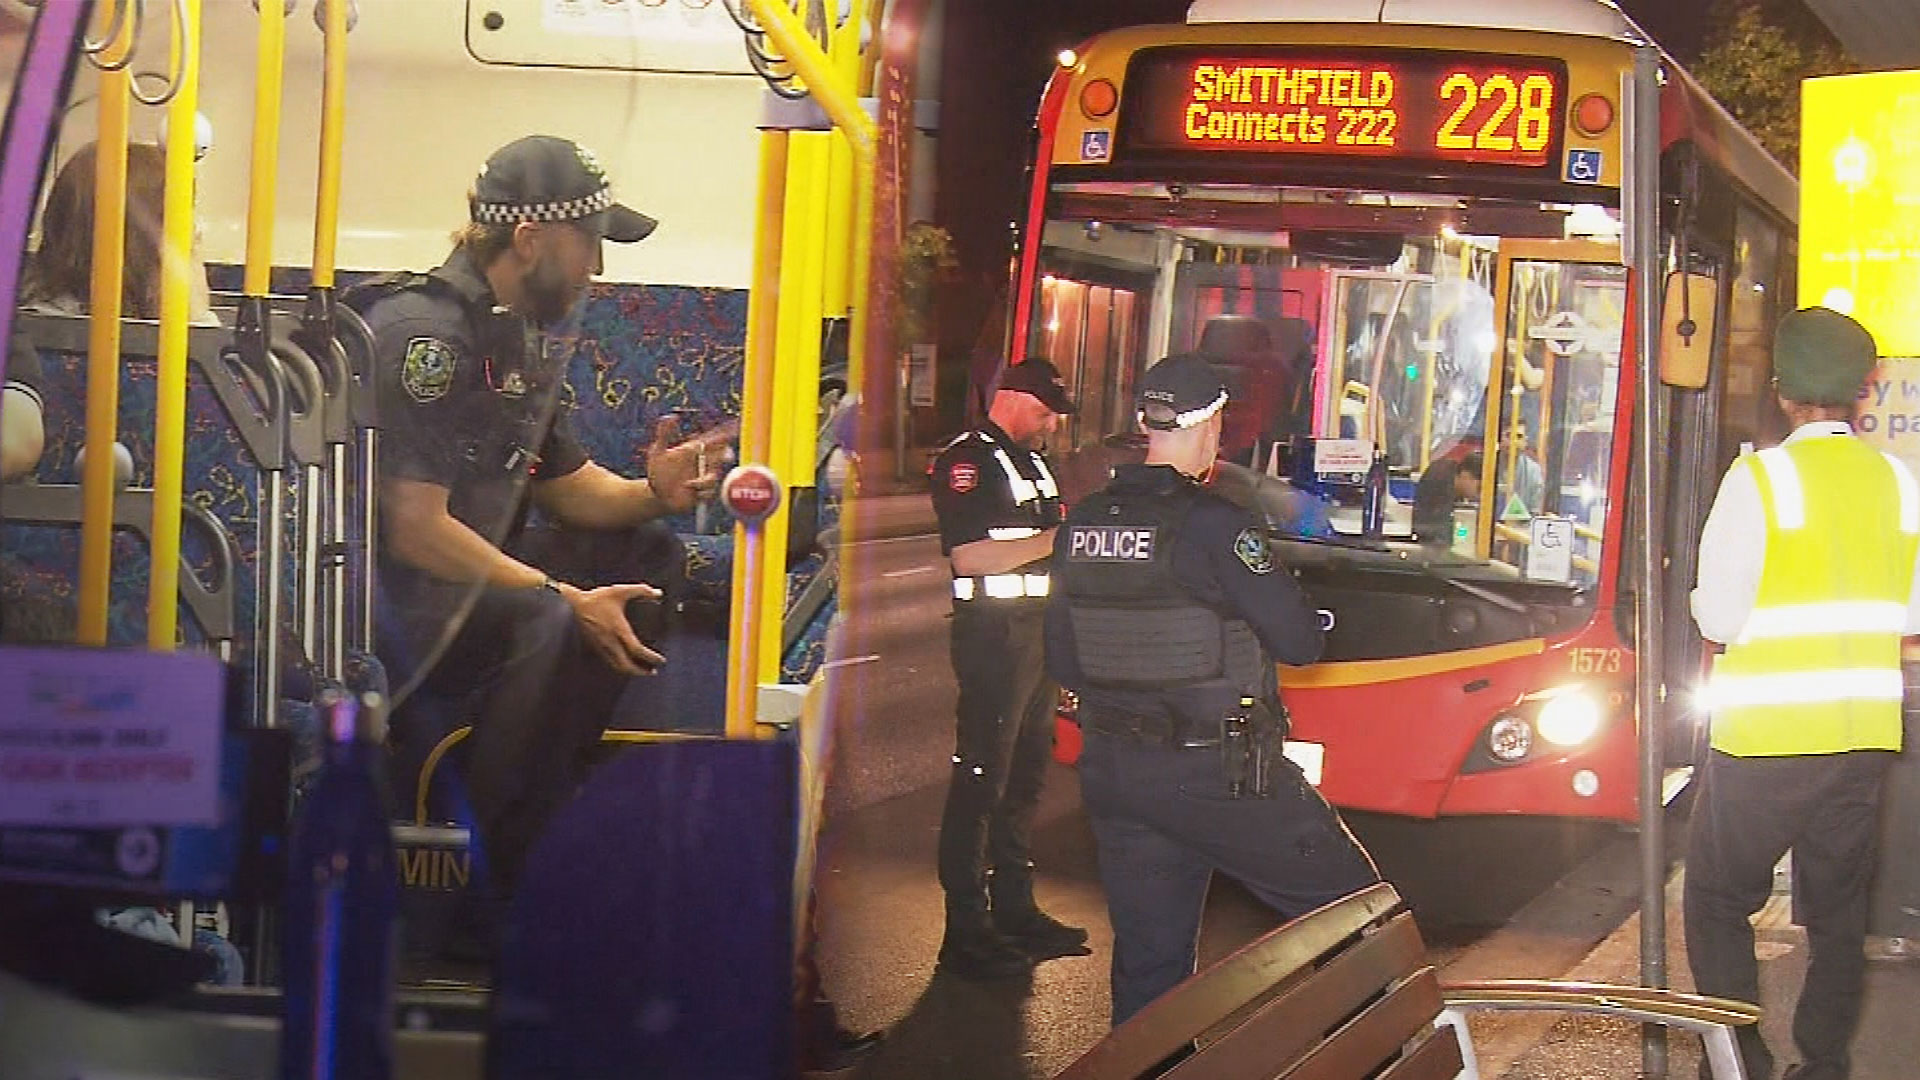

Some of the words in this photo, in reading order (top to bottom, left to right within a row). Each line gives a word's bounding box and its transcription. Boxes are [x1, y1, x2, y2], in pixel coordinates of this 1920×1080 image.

[1193, 65, 1395, 107] SMITHFIELD
[1185, 103, 1326, 143] Connects
[1336, 109, 1396, 147] 222
[1436, 73, 1554, 152] 228
[1143, 389, 1175, 403] POLICE
[1071, 530, 1151, 559] POLICE
[1567, 647, 1621, 673] 1573
